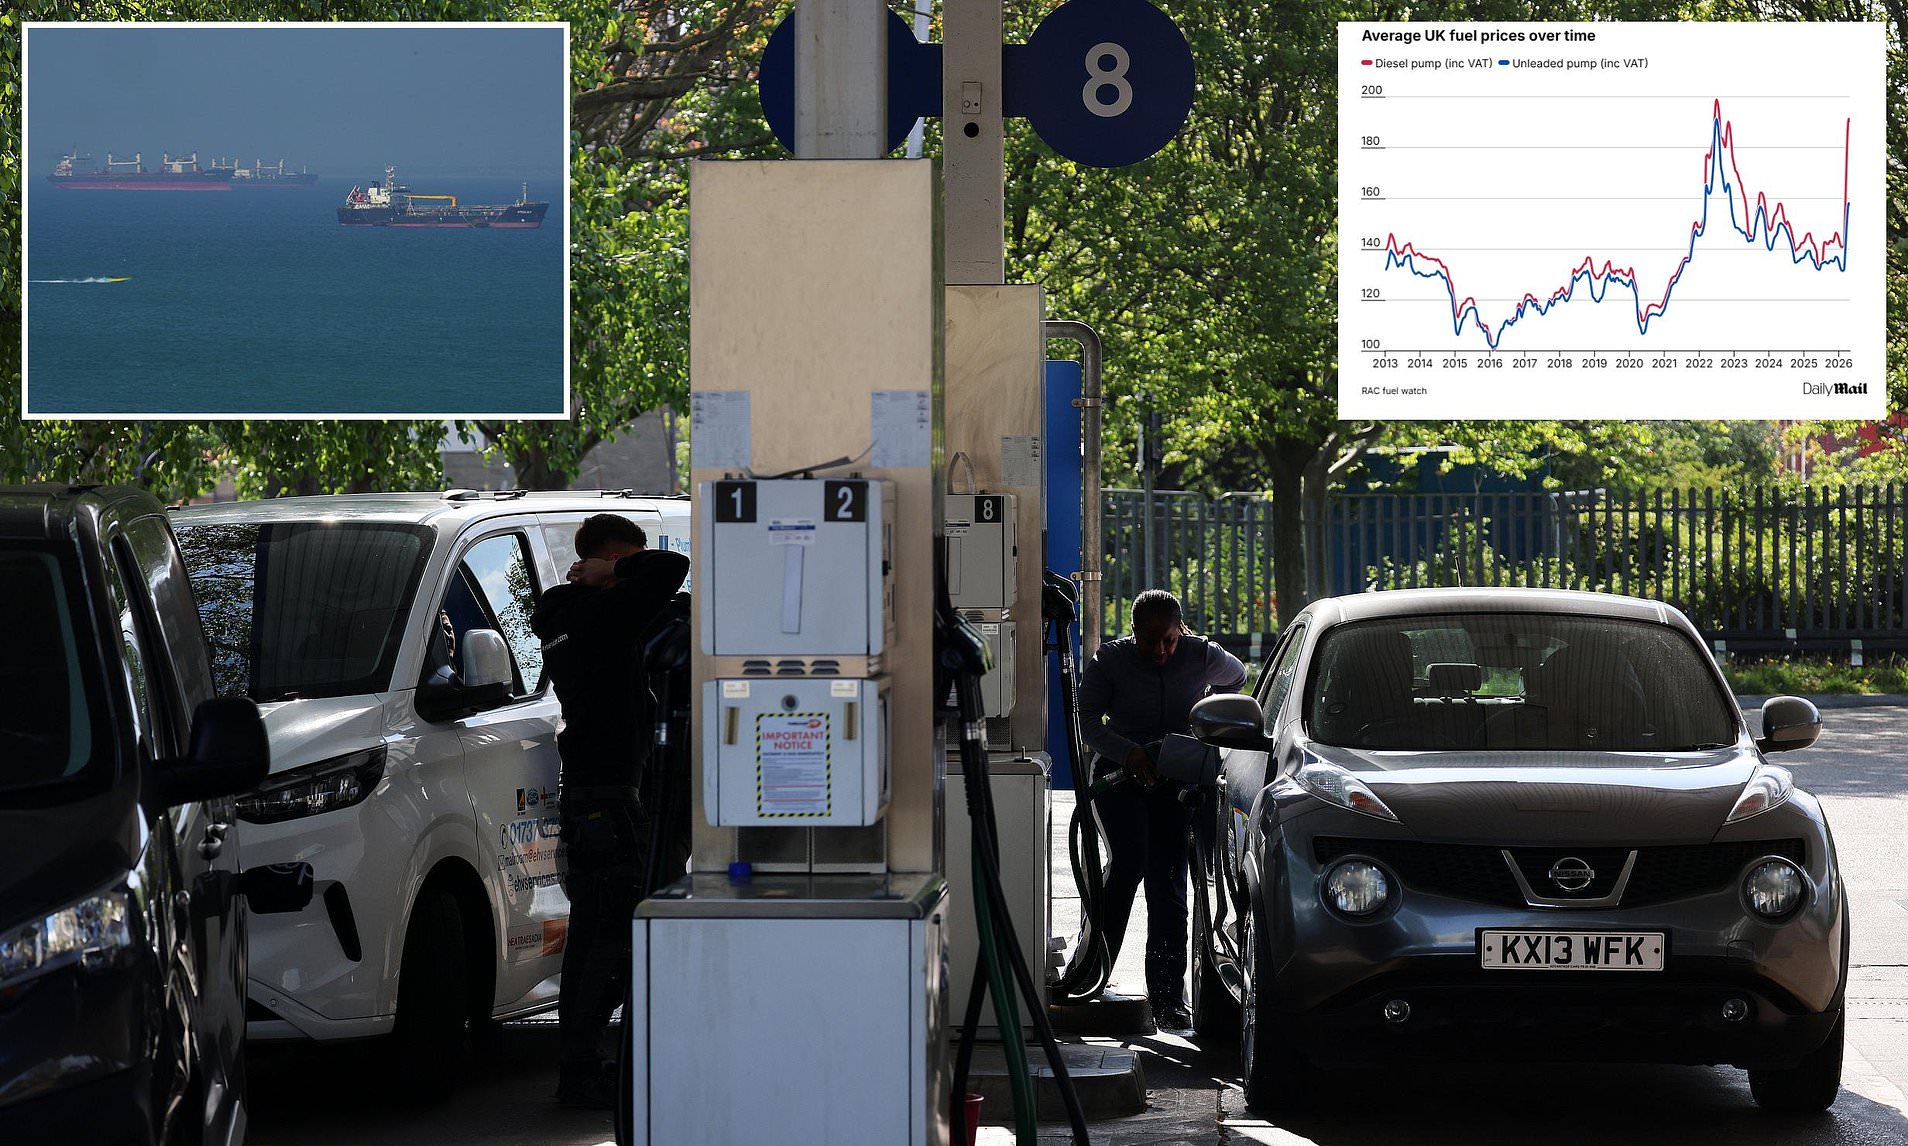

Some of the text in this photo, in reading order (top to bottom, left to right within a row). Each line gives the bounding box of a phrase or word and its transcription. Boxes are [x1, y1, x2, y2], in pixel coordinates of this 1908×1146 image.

[1082, 42, 1133, 118] 8
[730, 488, 743, 519] 1
[837, 486, 853, 518] 2
[983, 499, 994, 520] 8
[762, 731, 823, 740] IMPORTANT
[773, 741, 813, 750] NOTICE
[1555, 870, 1591, 878] NISSAN
[1502, 935, 1645, 965] KX13 WFK
